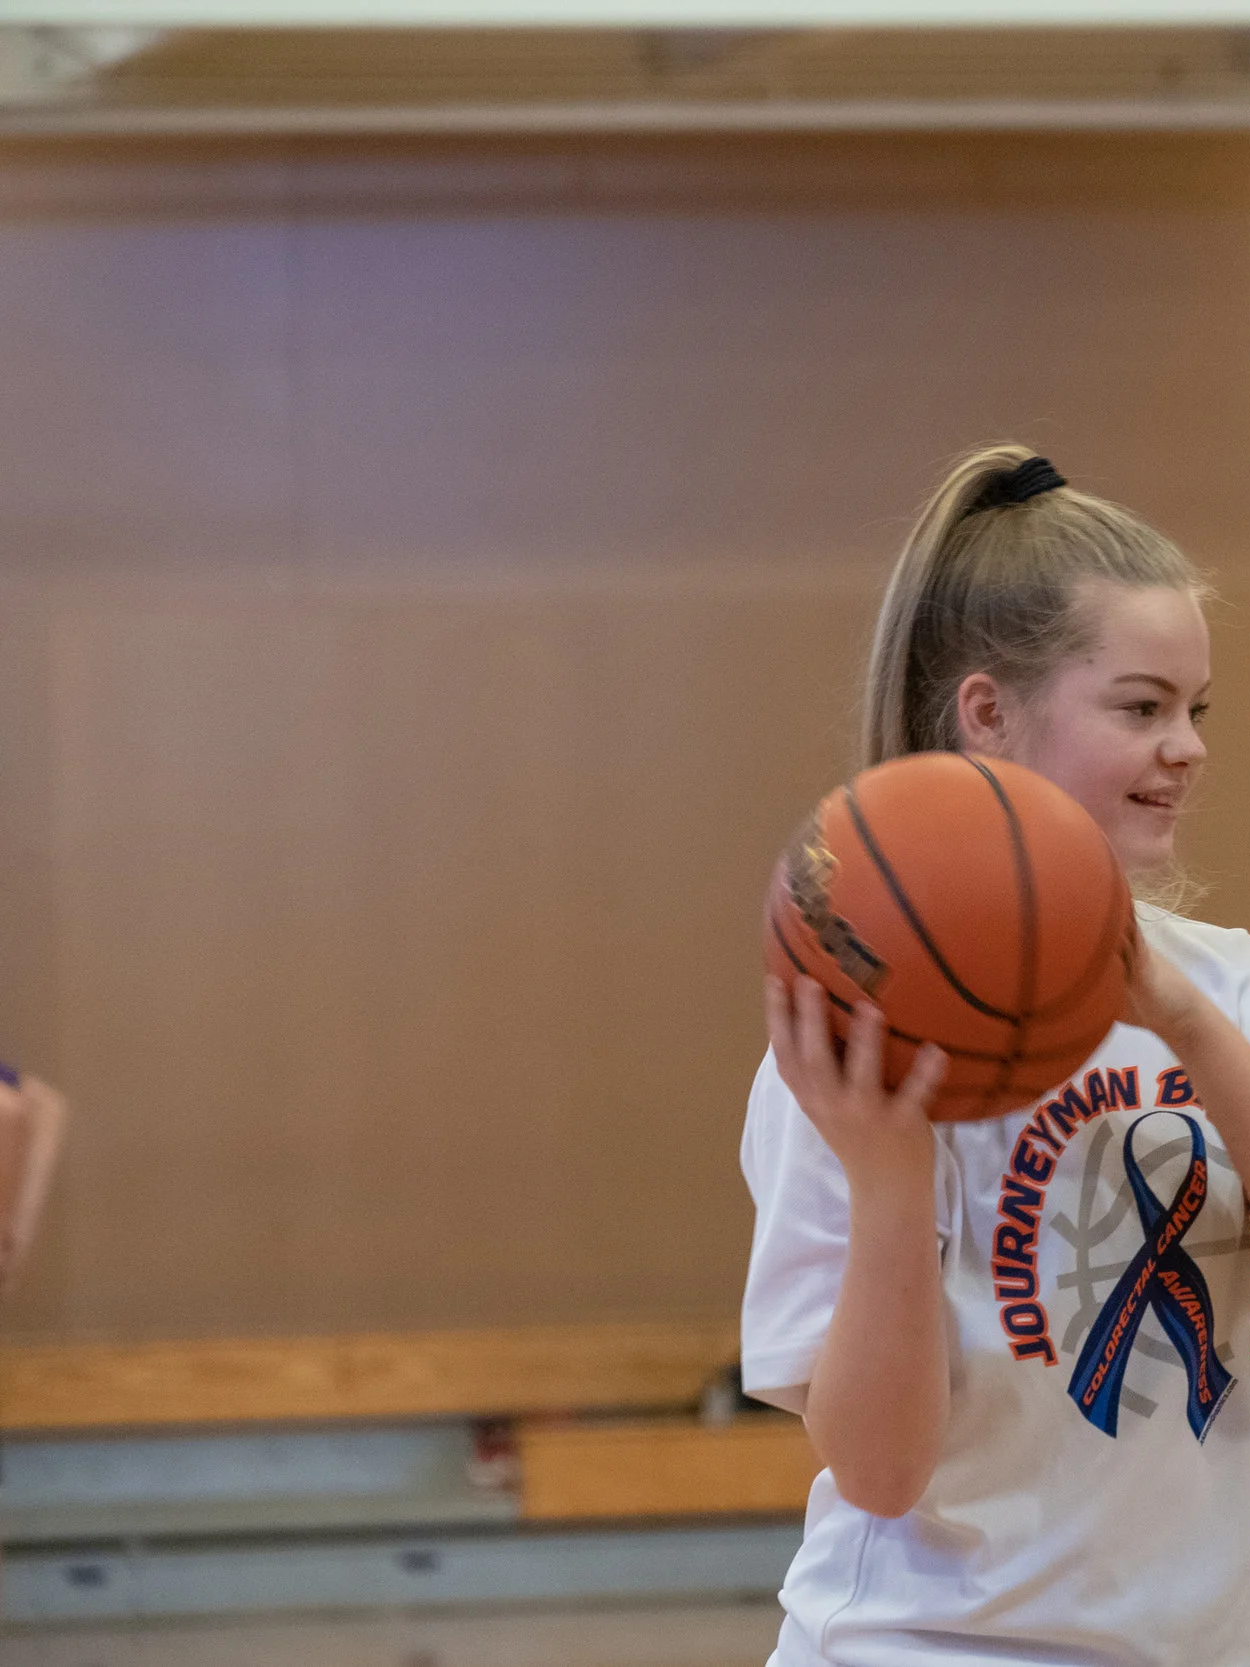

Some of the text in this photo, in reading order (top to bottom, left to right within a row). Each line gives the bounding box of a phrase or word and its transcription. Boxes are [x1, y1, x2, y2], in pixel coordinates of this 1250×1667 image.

[990, 1065, 1141, 1367] JOURNEYMAN
[1082, 1159, 1207, 1406] COLORECTAL CANCER
[1158, 1270, 1213, 1404] AWARENESS
